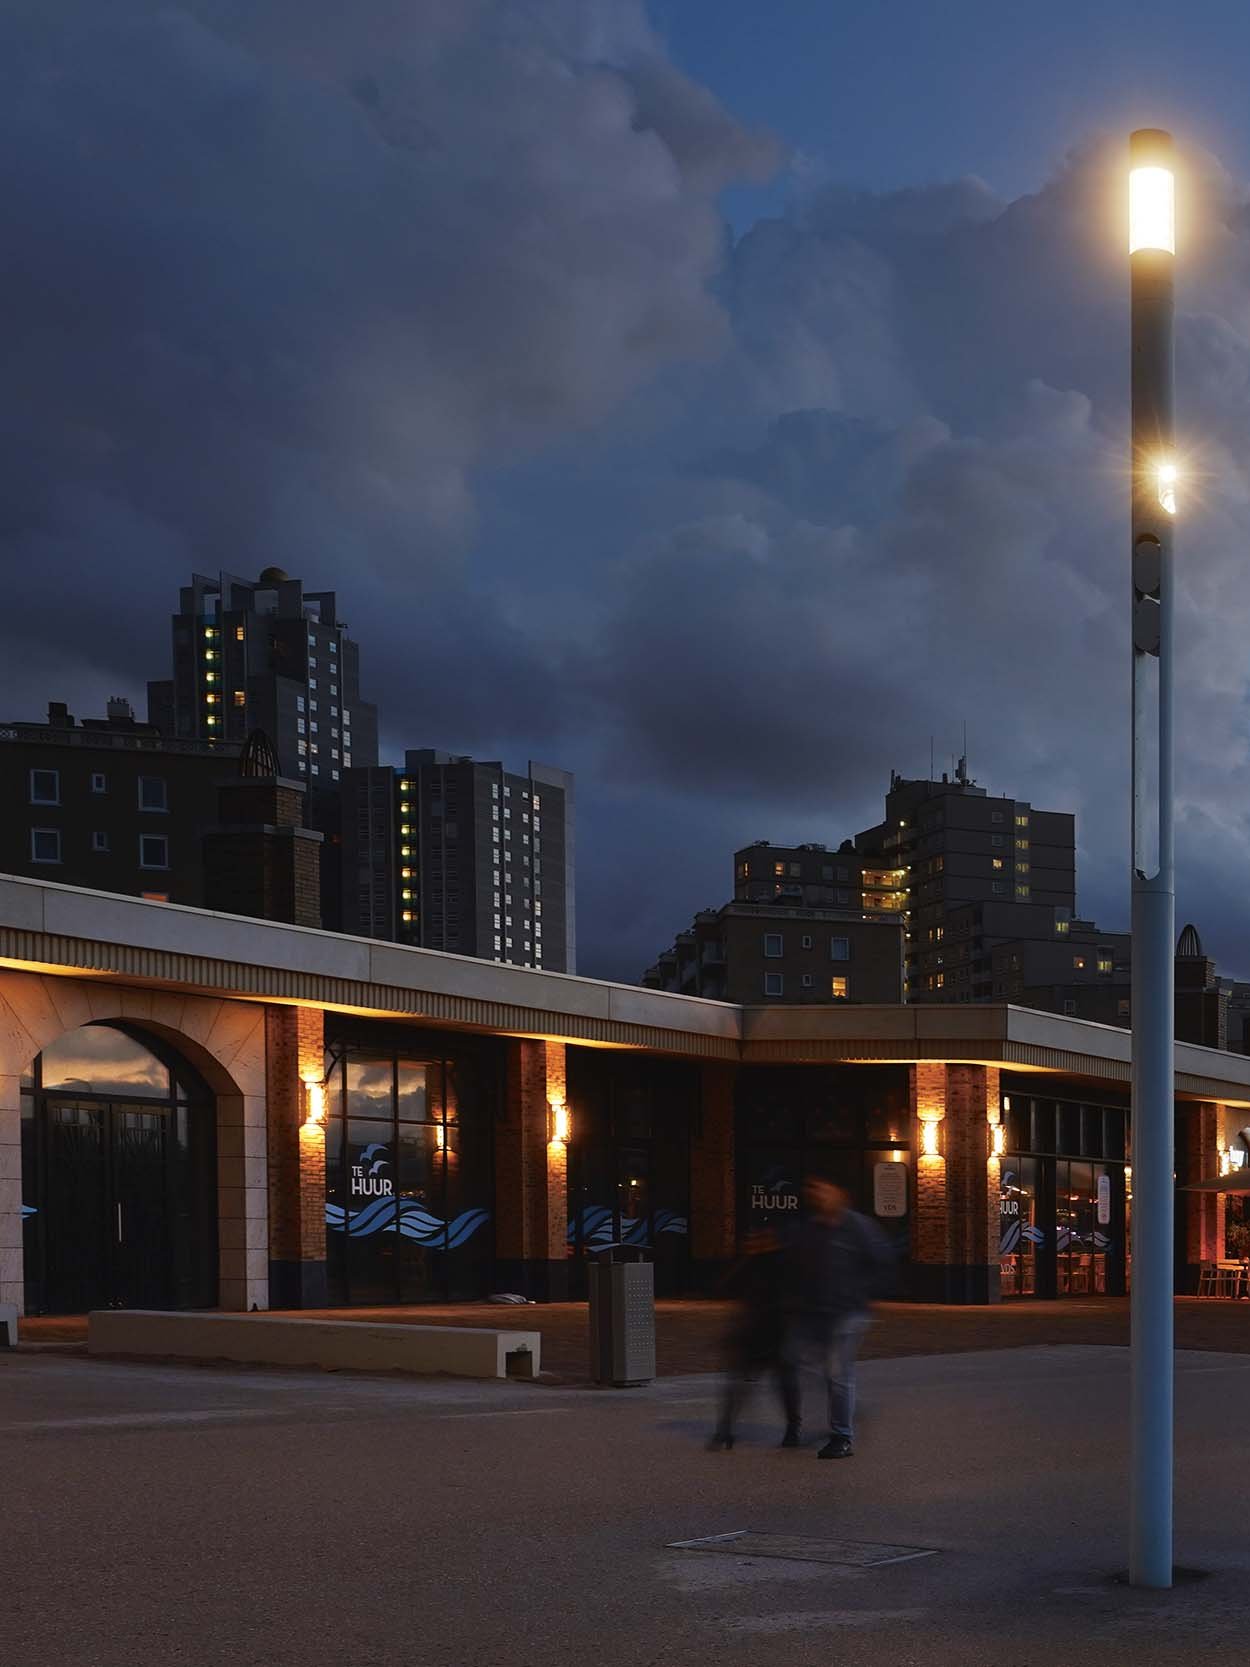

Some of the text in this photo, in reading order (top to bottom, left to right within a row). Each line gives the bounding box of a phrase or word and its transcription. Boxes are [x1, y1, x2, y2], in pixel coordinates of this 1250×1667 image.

[352, 1166, 363, 1177] TE
[352, 1178, 393, 1196] HUUR
[752, 1185, 765, 1195] TE
[752, 1196, 799, 1210] HUUR
